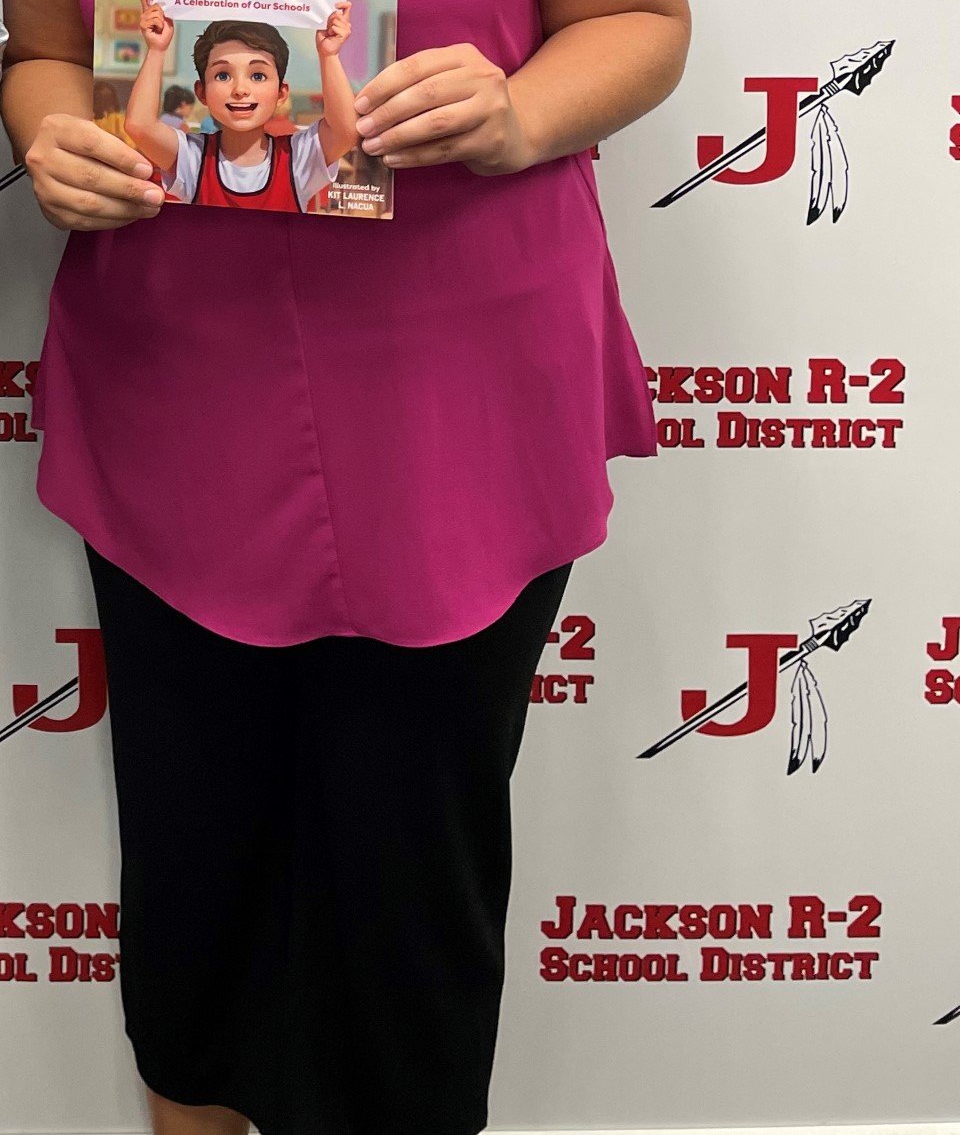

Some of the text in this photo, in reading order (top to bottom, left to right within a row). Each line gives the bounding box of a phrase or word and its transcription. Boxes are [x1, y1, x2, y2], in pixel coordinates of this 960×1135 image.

[241, 0, 252, 9] of
[253, 1, 271, 10] Our
[273, 2, 310, 12] Schools
[327, 190, 385, 203] KIT LAURENCE
[332, 182, 381, 193] Illustrated by
[347, 201, 374, 211] NACUA
[644, 357, 905, 404] KSON R-2
[716, 410, 903, 449] DISTRICT
[546, 616, 596, 660] -2
[540, 894, 882, 939] JACKSON R-2
[539, 946, 879, 982] SCHOOL DISTRICT
